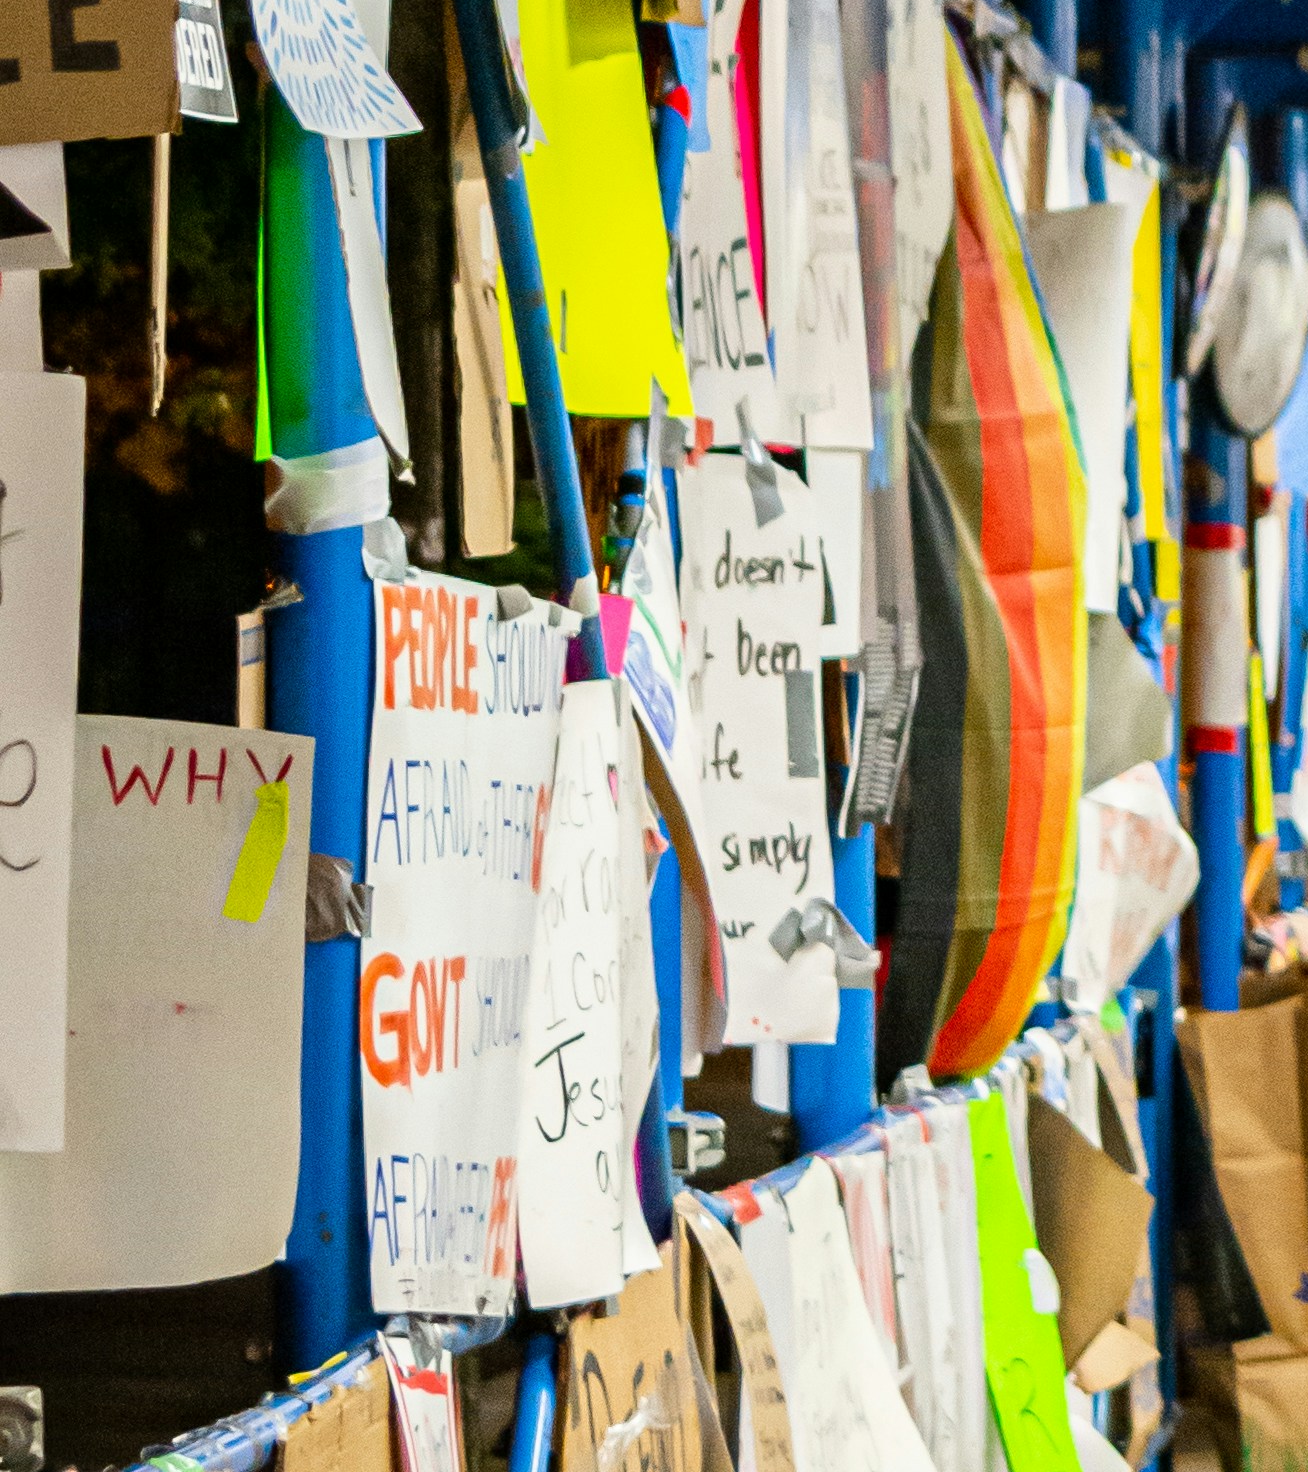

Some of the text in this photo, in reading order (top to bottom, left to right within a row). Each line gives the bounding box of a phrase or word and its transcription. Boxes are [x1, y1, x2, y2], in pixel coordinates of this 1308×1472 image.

[715, 530, 816, 589] doesn't
[383, 587, 479, 714] PEOPLE
[373, 756, 473, 867] AFRAID
[360, 951, 466, 1092] GOVT
